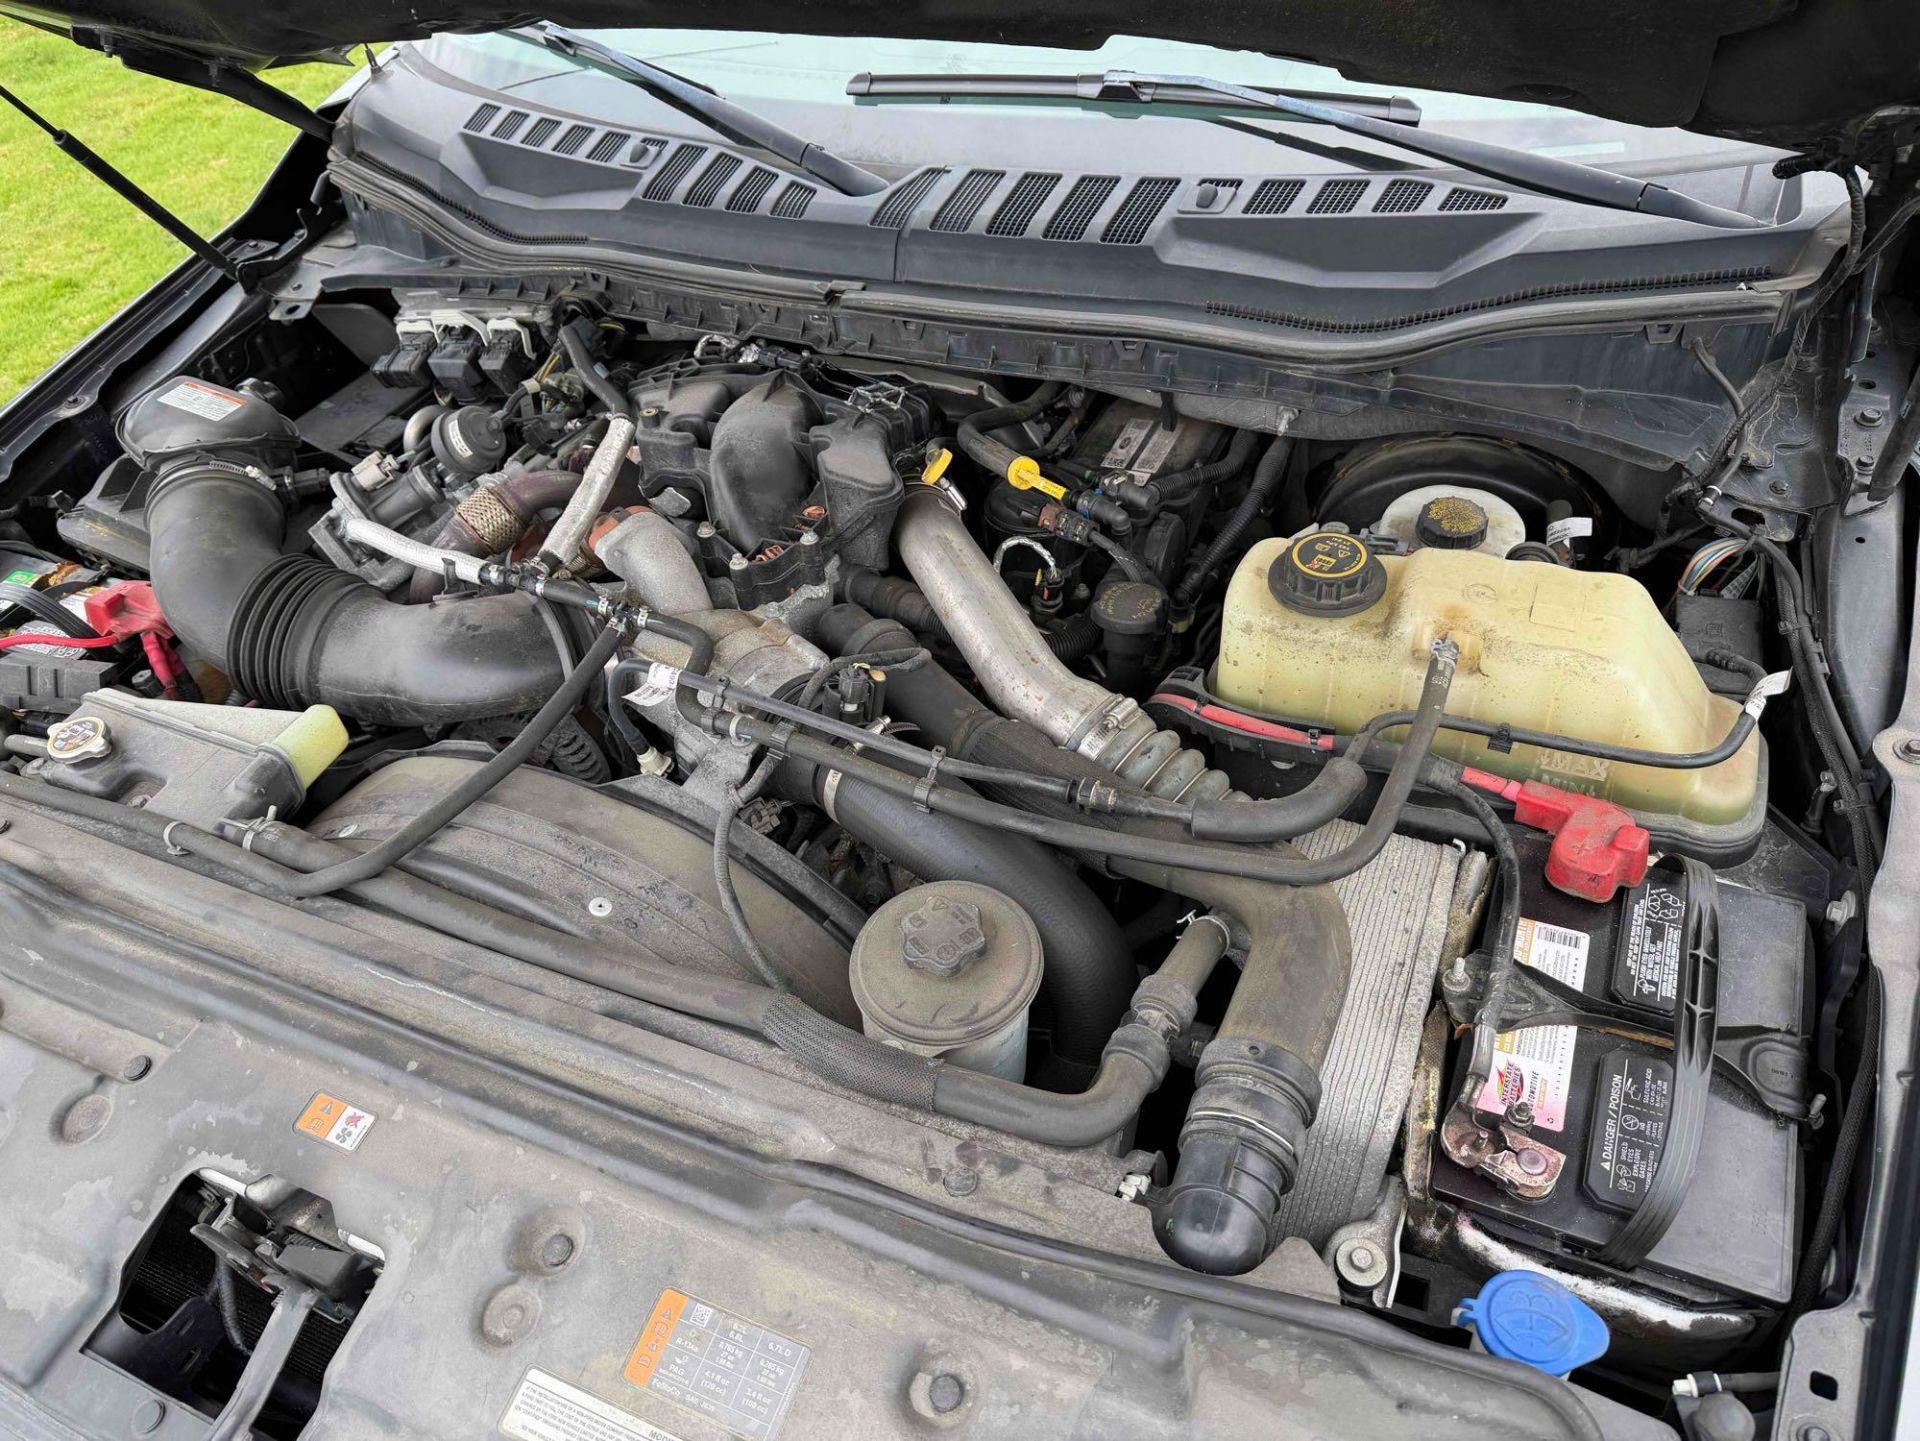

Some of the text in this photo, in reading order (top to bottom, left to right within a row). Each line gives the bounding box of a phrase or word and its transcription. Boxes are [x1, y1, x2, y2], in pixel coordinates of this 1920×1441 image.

[1500, 1062, 1513, 1104] INTERSTATE
[1508, 1066, 1521, 1105] BATTERIES
[1525, 1070, 1539, 1109] UTOMOTIVE
[1608, 1073, 1622, 1109] POISON
[1601, 1118, 1616, 1159] DANGER
[669, 1364, 684, 1376] PAG
